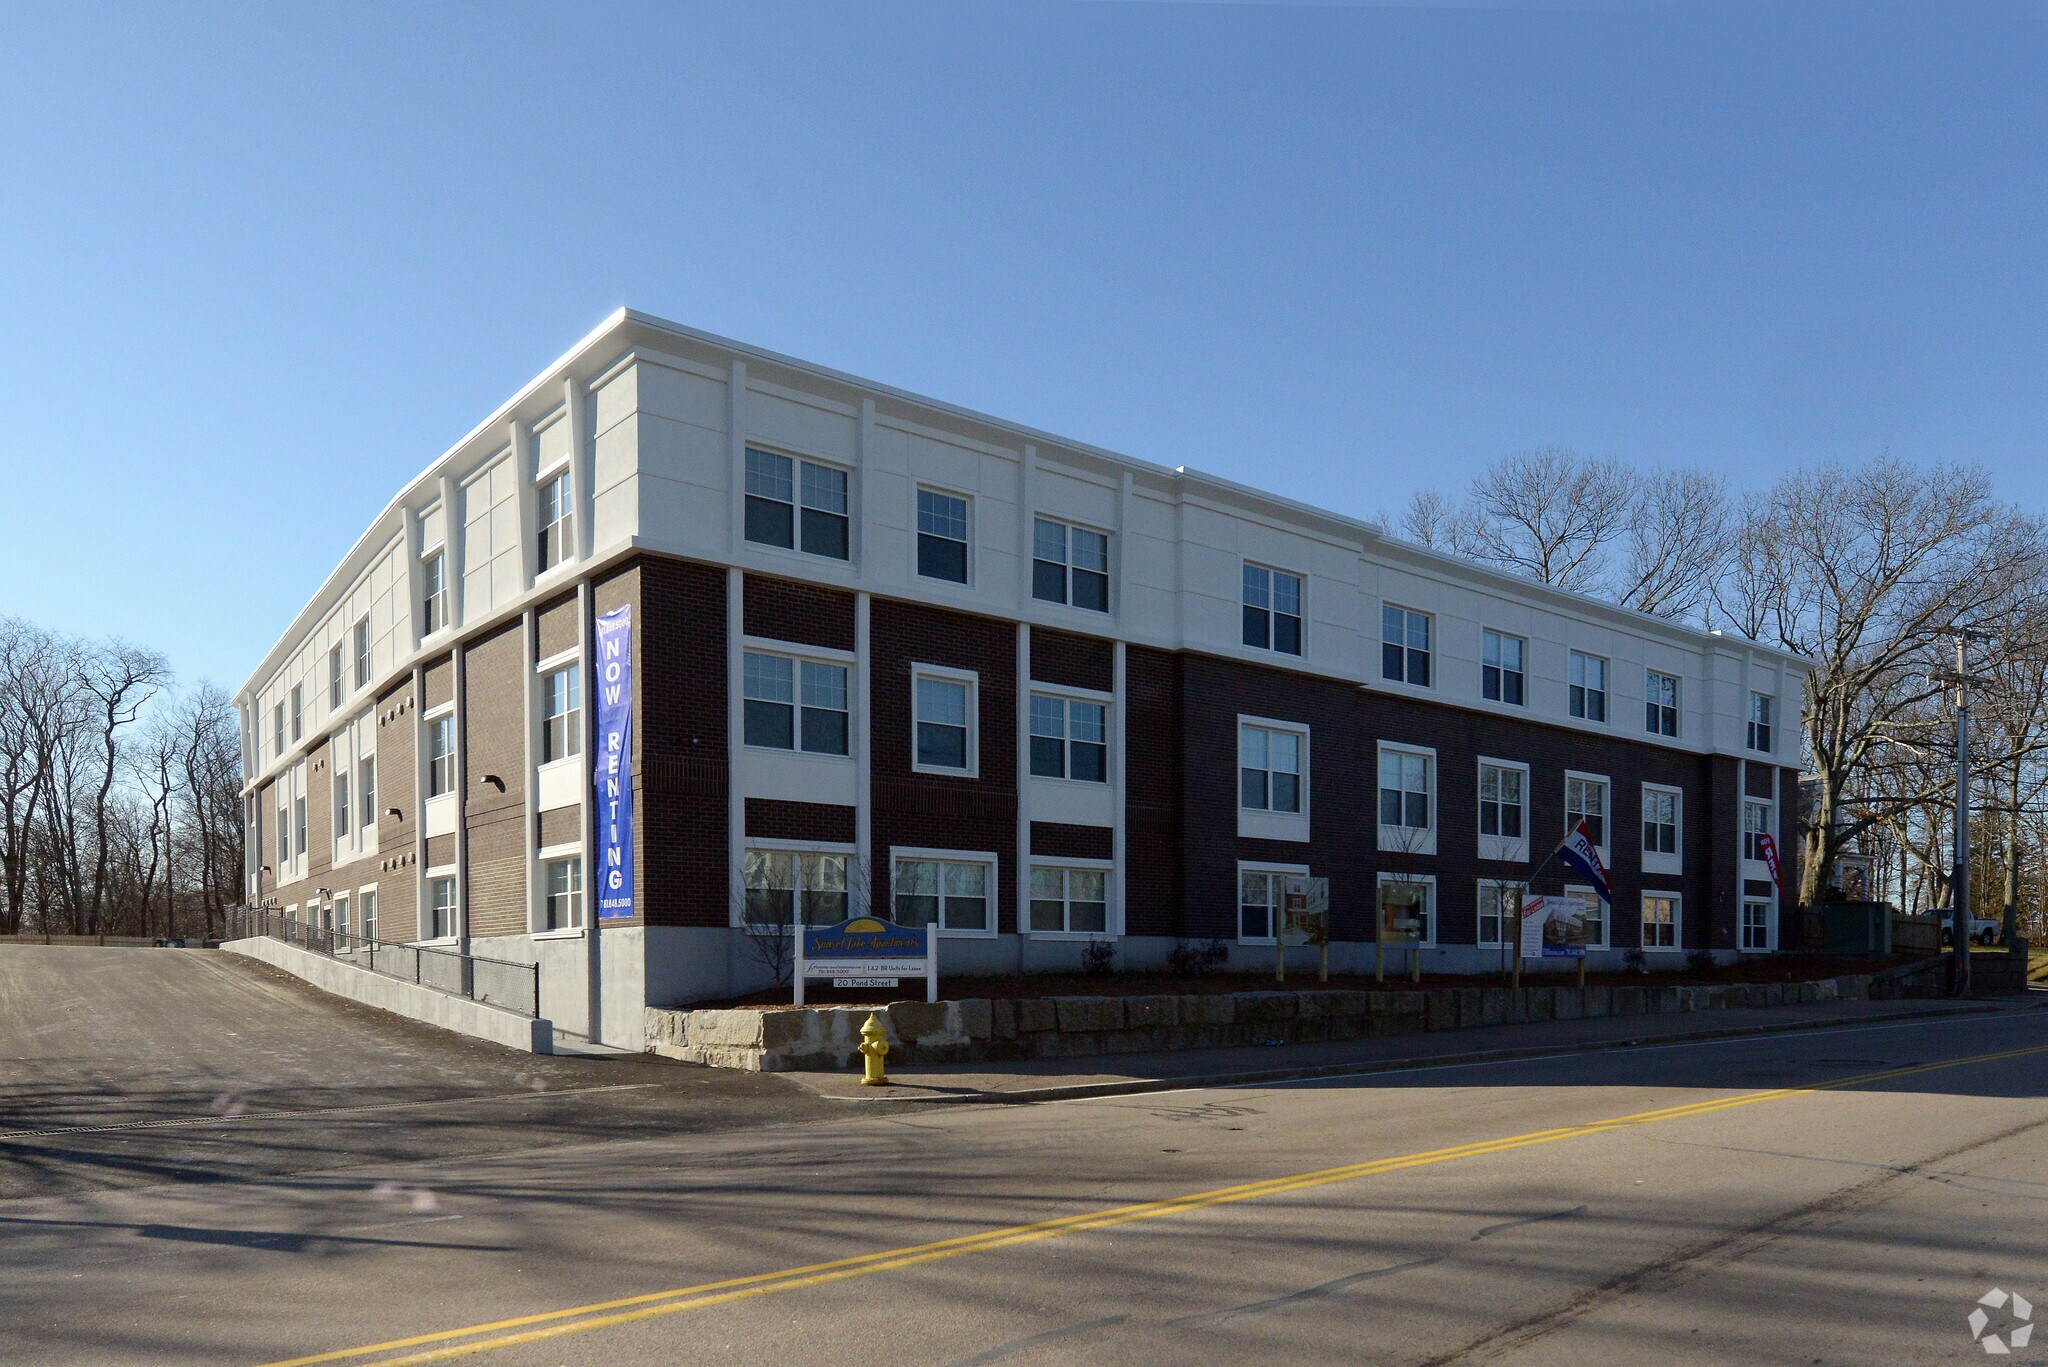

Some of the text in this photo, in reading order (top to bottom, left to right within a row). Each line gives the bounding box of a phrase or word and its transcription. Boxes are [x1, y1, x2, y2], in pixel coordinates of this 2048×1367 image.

[605, 637, 623, 890] NOW RENTING
[837, 978, 892, 987] 20 Pond Street
